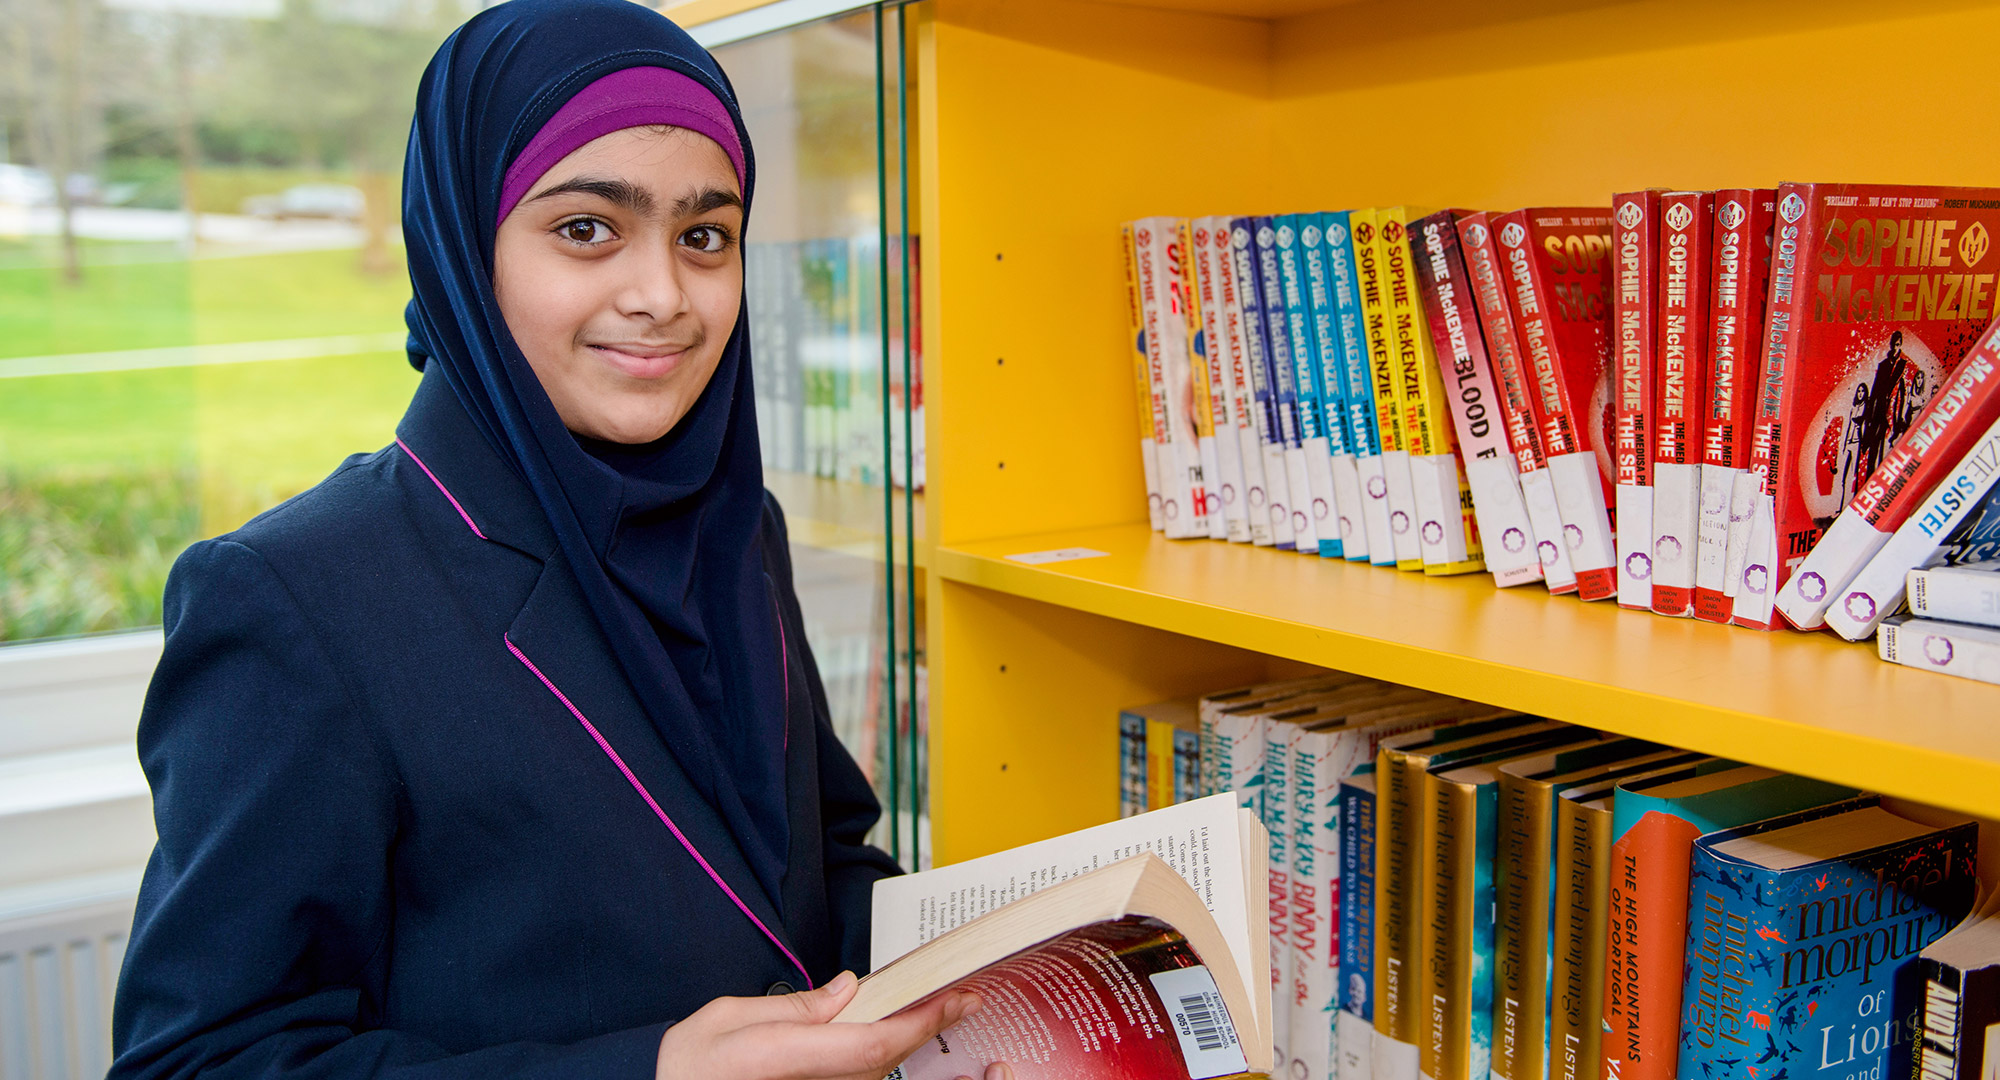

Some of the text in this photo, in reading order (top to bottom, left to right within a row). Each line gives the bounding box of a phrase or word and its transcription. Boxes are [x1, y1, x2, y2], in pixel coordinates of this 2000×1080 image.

[1820, 218, 1957, 268] SOPHIE
[1261, 249, 1282, 309] SOPHIE
[1280, 249, 1301, 309] SOPHIE
[1307, 249, 1327, 310] SOPHIE
[1422, 222, 1468, 364] SOPHIE McKENZIE
[1814, 273, 1995, 323] McKENZIE
[1331, 248, 1365, 398] SOPHIE McKENZIE
[1359, 248, 1393, 399] SOPHIE McKENZIE
[1387, 245, 1421, 400] SOPHIE McKENZIE
[1472, 248, 1525, 409] SOPHIE McKENZIE
[1509, 248, 1562, 415] SOPHIE McKENZIE
[1620, 231, 1641, 411] SOPHIE McKENZIE
[1664, 233, 1687, 418] SOPHIE McKENZIE
[1713, 231, 1740, 420] SOPHIE McKENZIE
[1763, 225, 1798, 419] SOPHIE McKENZIE
[1379, 404, 1392, 430] THE
[1406, 405, 1419, 433] THE
[1453, 355, 1490, 439] BLOOD
[1558, 414, 1569, 431] THE
[1907, 354, 1994, 457] McKENZIE
[1509, 412, 1529, 446] THE
[1522, 409, 1543, 463] THE MEDUSA
[1544, 417, 1564, 453] THE
[1619, 414, 1635, 449] THE
[1634, 413, 1646, 472] THE MEDUSA
[1659, 422, 1675, 457] THE
[1676, 422, 1685, 440] THE
[1706, 425, 1723, 460] THE
[1723, 424, 1732, 443] THE
[1753, 422, 1771, 459] THE
[1768, 423, 1782, 485] THE MEDUSA
[1875, 458, 1922, 513] THE MEDUSA
[1877, 450, 1912, 486] THE
[1788, 530, 1816, 553] THE
[1658, 589, 1678, 597] SIMON
[1698, 609, 1726, 618] SCHUSTER
[1702, 594, 1721, 602] SIMON
[1436, 790, 1455, 880] michael
[1502, 787, 1530, 992] michael morpurgo
[1795, 849, 1952, 942] michael
[1562, 816, 1592, 1027] michael morpurgo
[1611, 887, 1622, 1016] OF PORTUGAL
[1624, 856, 1641, 1063] THE HIGH MOUNTAINS
[1690, 890, 1724, 1049] morpurgo
[1718, 909, 1754, 1047] michael
[1387, 957, 1402, 1014] LISTEN
[1858, 990, 1886, 1017] of
[1175, 1013, 1191, 1036] 00570
[1211, 1010, 1220, 1025] HIGH
[1217, 1026, 1230, 1050] SCHOOL
[1432, 994, 1447, 1054] LISTEN
[1504, 997, 1519, 1058] LISTEN
[1817, 1012, 1917, 1071] Lions
[1924, 979, 1958, 1052] ANDY
[1607, 1057, 1621, 1080] YA
